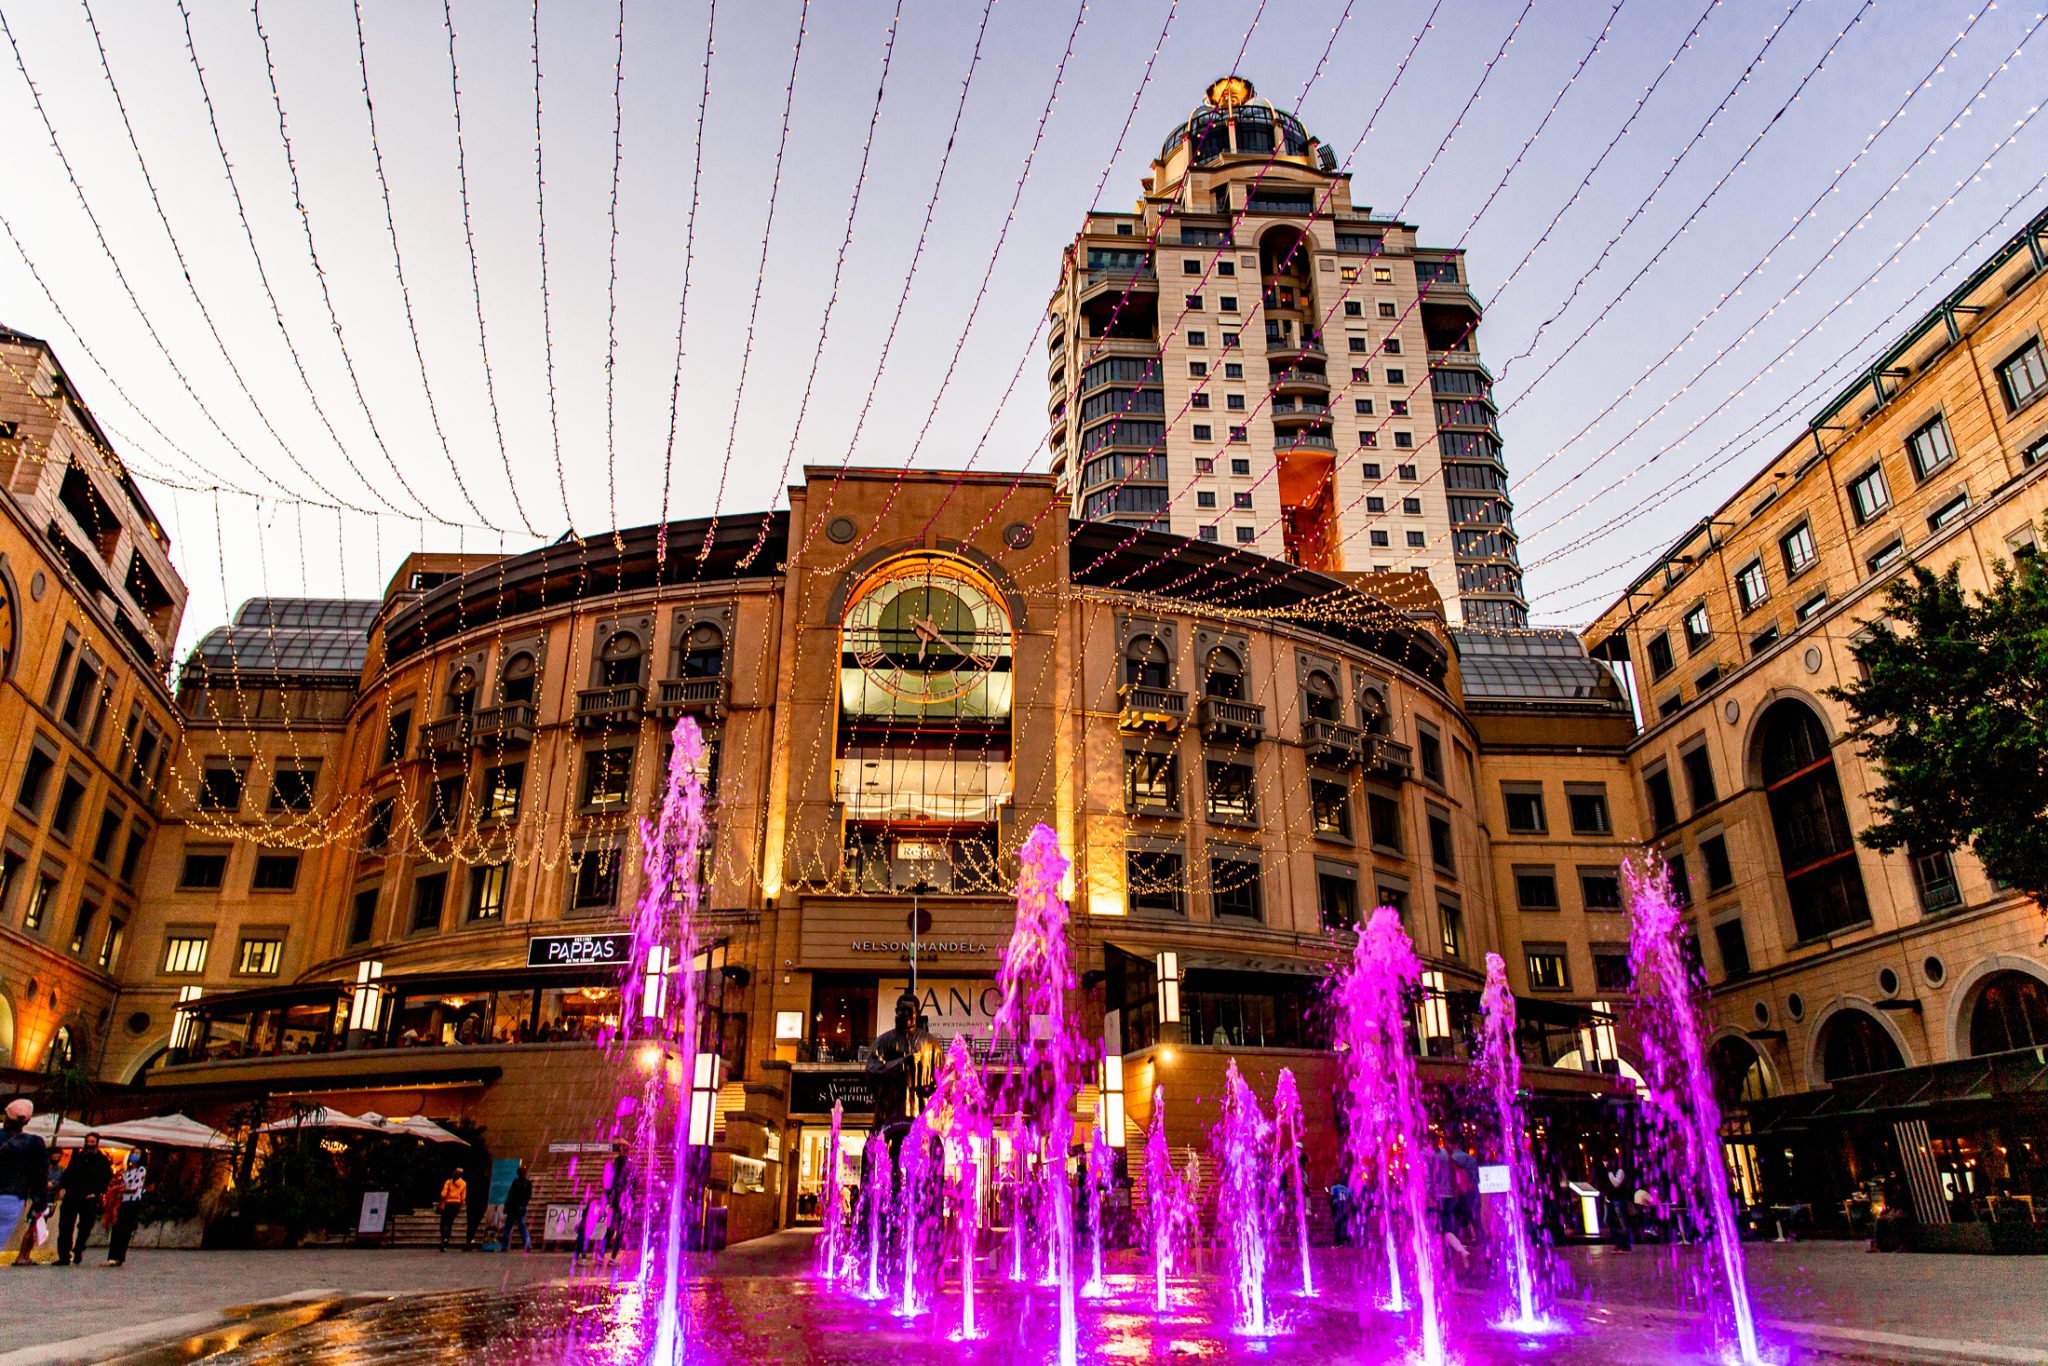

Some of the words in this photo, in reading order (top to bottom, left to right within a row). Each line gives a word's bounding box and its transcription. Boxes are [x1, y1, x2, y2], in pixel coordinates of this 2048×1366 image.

[549, 941, 614, 959] PAPPAS
[852, 941, 910, 952] NELSON
[917, 941, 987, 952] MANDELA
[548, 1209, 577, 1223] PAP
